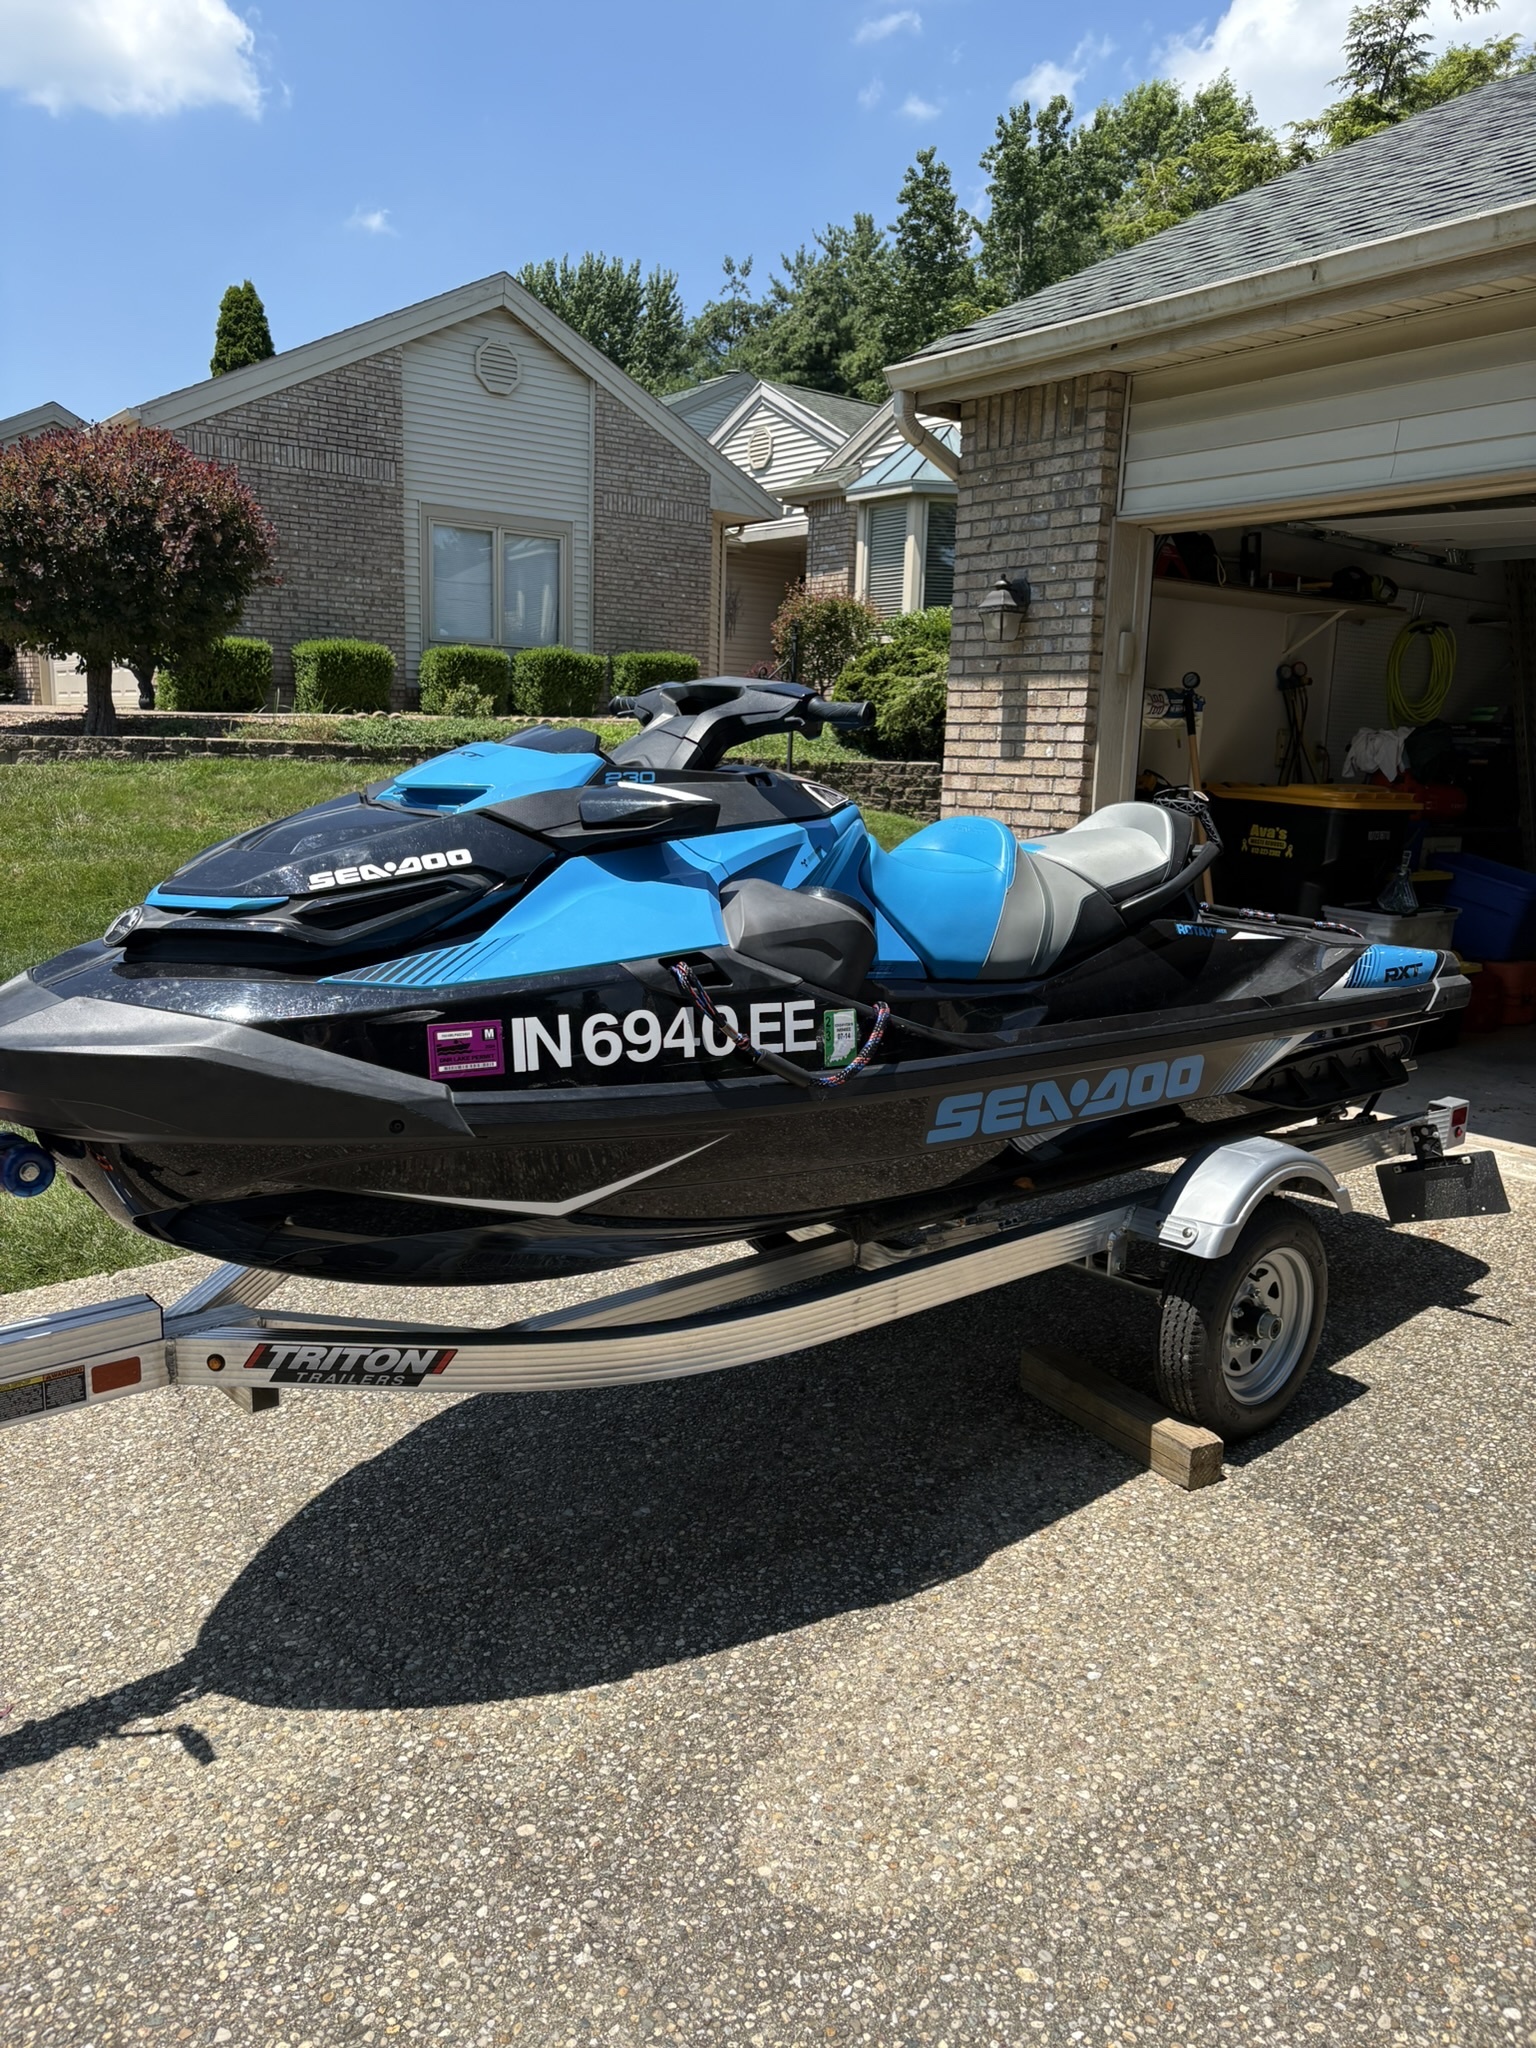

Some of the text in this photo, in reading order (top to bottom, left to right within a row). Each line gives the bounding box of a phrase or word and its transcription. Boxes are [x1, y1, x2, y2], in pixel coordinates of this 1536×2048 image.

[605, 771, 656, 784] 230
[1250, 824, 1288, 840] Ava's
[1175, 922, 1214, 938] ROTAX
[1384, 962, 1423, 983] RXT
[484, 1028, 494, 1040] M
[511, 1000, 817, 1072] IN 6940 EE
[267, 1345, 438, 1373] TRITON
[296, 1371, 406, 1386] TRAILERS
